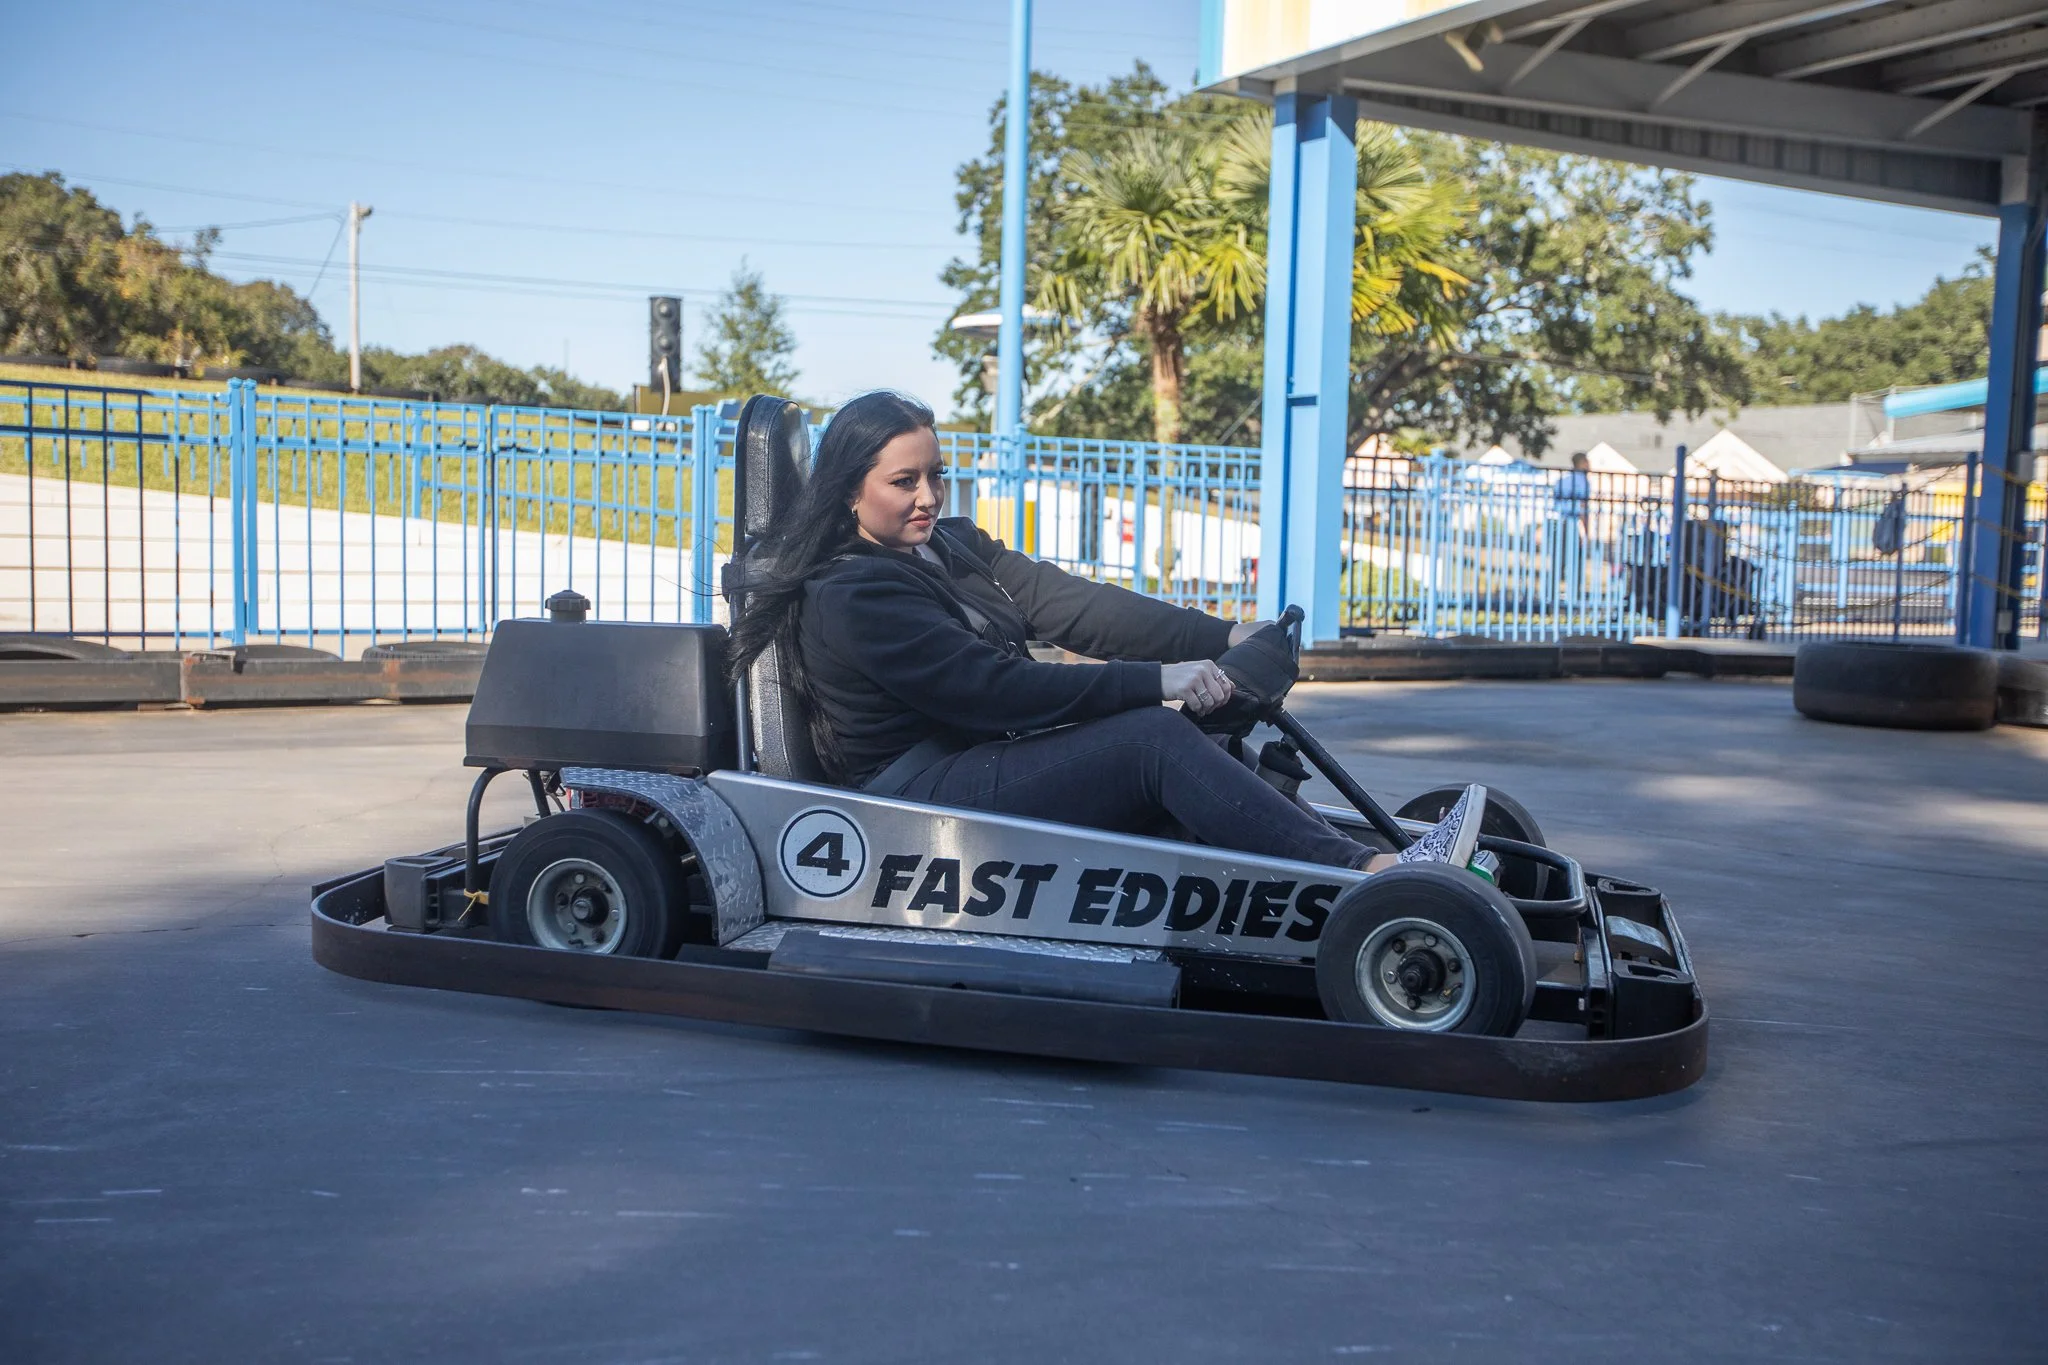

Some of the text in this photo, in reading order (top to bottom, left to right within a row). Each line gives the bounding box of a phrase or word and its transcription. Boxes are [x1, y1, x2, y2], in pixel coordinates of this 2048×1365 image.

[796, 831, 850, 877] 4
[871, 854, 1343, 942] FAST EDDIES
